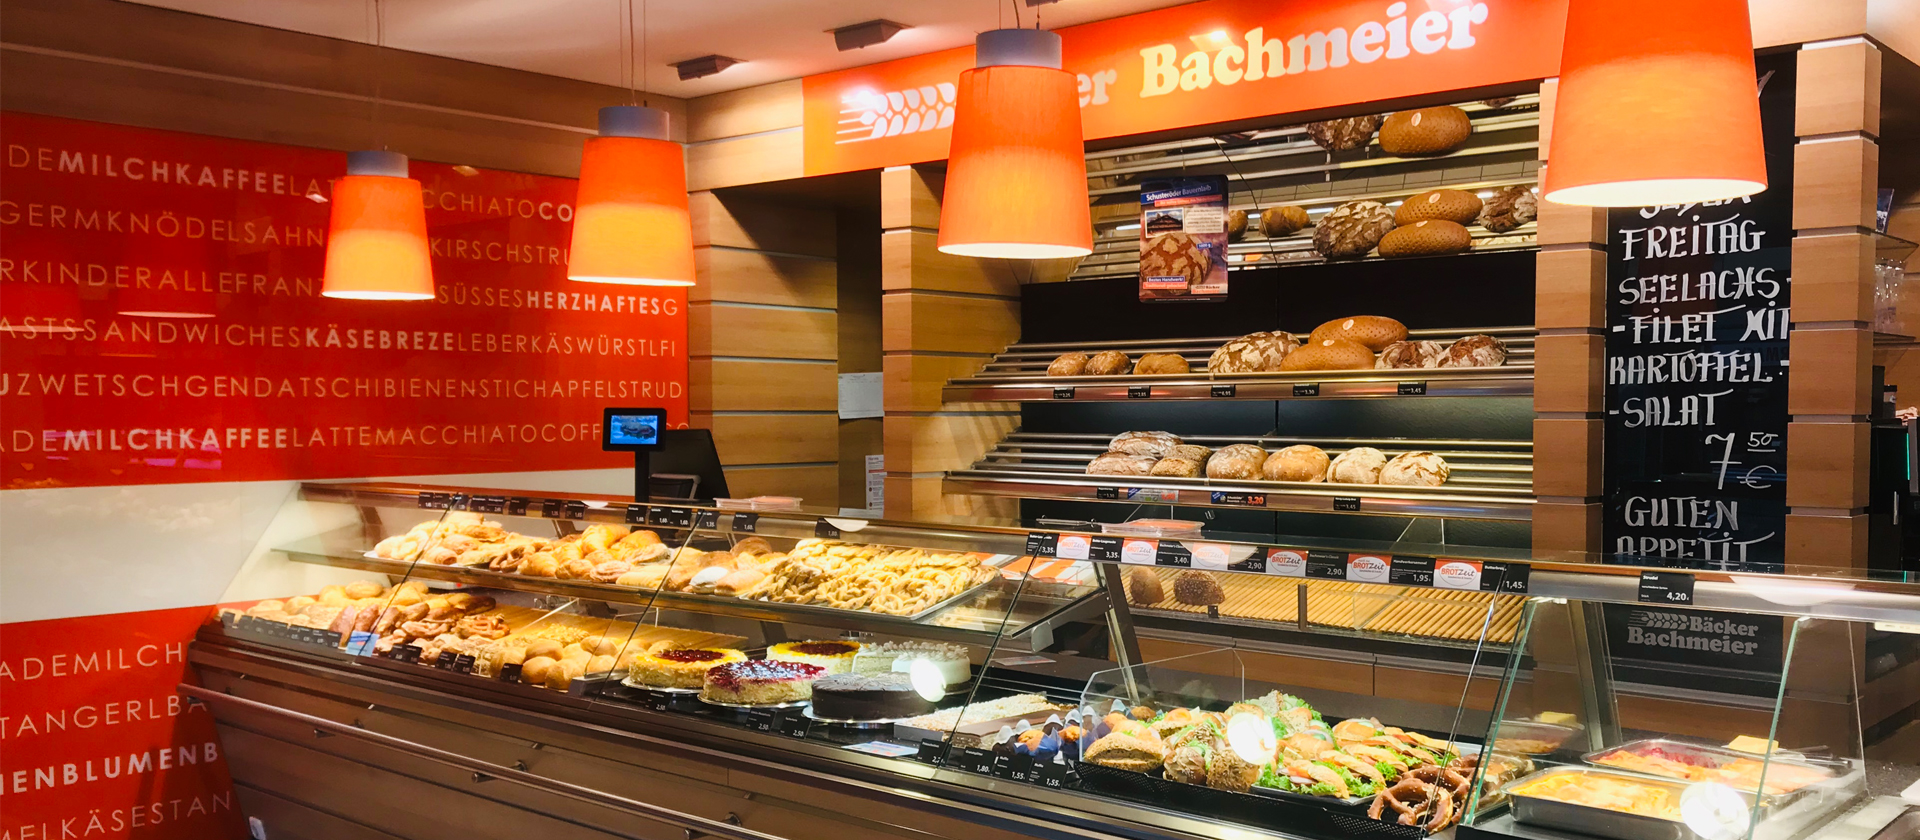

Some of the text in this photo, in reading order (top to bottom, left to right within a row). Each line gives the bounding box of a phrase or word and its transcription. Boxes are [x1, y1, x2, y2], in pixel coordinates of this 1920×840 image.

[1139, 0, 1489, 98] Bachmeier
[1705, 432, 1742, 490] 7
[1624, 496, 1739, 530] GUTEN
[1627, 626, 1758, 656] Bachmeier
[1689, 615, 1758, 637] Bäcker
